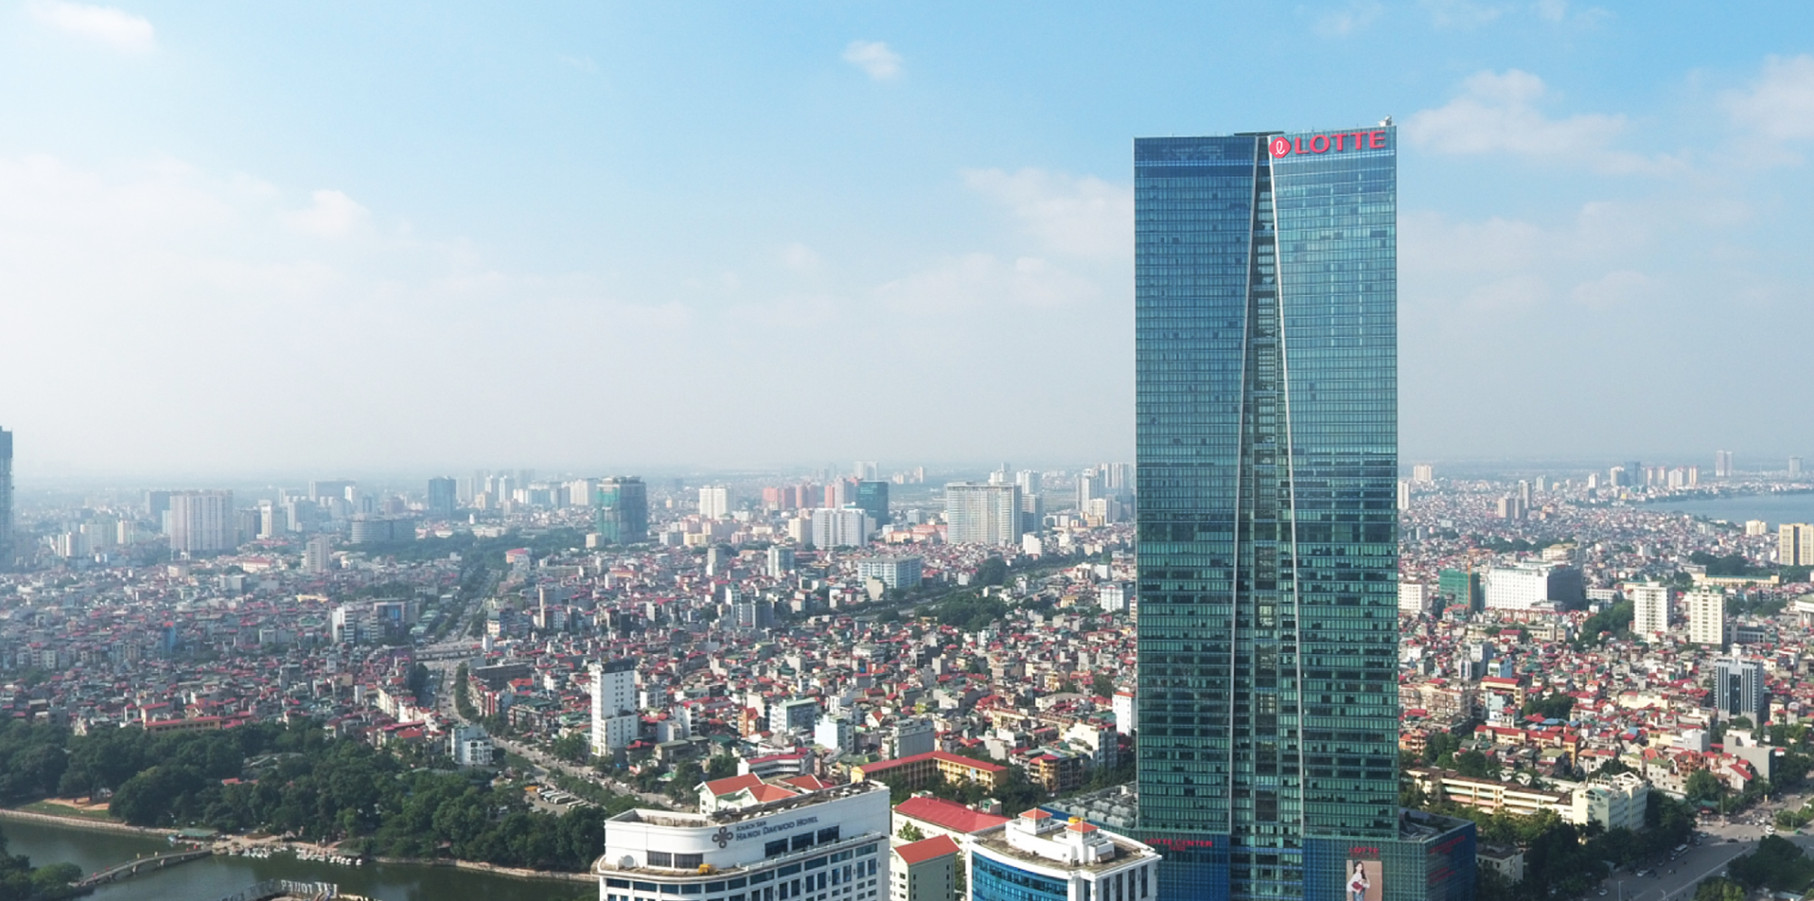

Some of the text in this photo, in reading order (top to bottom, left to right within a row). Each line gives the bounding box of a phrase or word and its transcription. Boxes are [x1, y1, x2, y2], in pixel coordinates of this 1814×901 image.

[1294, 131, 1385, 154] LOTTE
[763, 821, 795, 835] DAEWOO
[796, 816, 818, 827] HOTEL
[1144, 838, 1172, 846] LOTTE
